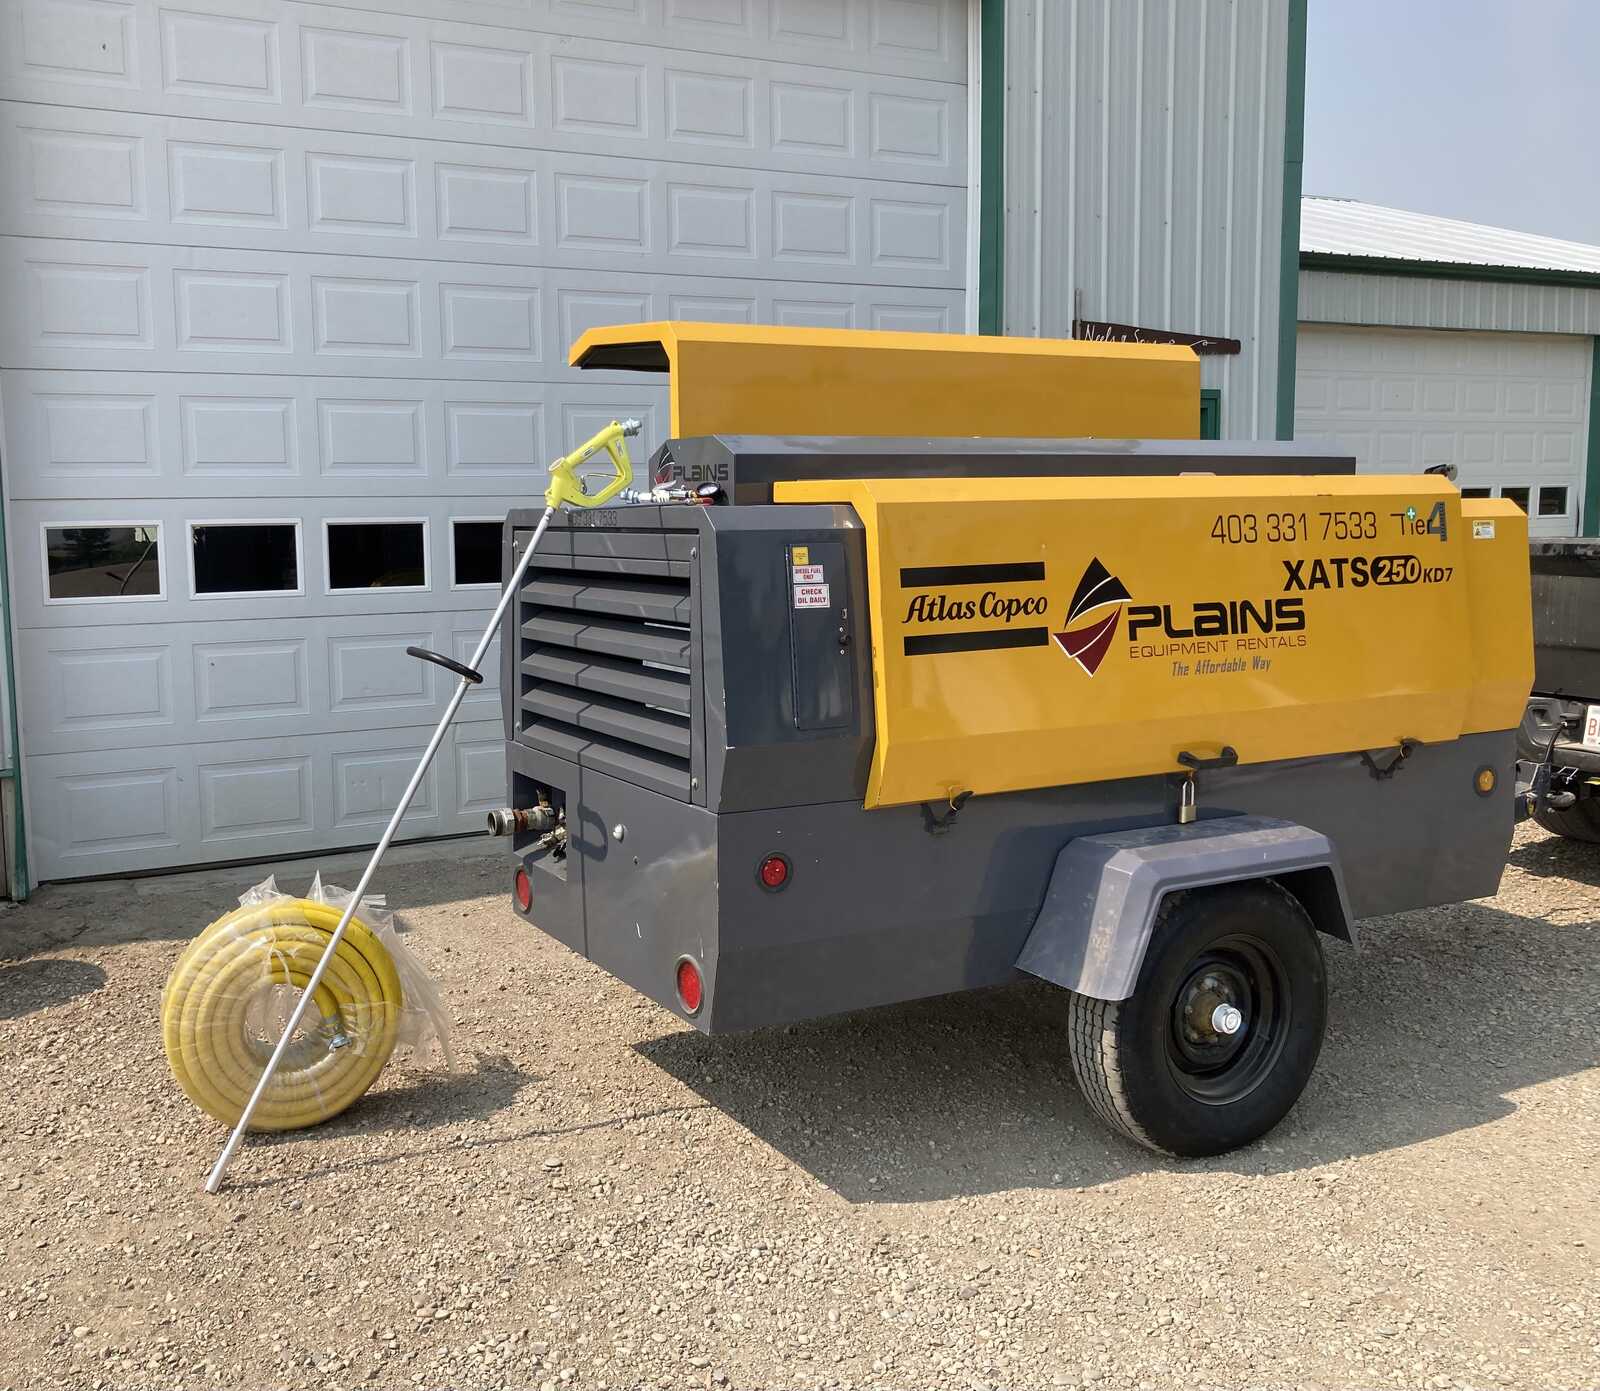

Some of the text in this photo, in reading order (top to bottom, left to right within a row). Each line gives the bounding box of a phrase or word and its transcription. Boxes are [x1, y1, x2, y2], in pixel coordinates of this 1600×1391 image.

[1210, 514, 1258, 544] 403
[1266, 512, 1308, 542] 331
[1318, 511, 1377, 541] 7533
[809, 596, 827, 604] DAILY
[901, 591, 1048, 623] Atlas Copco
[1129, 635, 1307, 659] EQUIPMENT RENTALS
[1172, 655, 1272, 677] The Affordable Way
[1588, 718, 1600, 735] B
